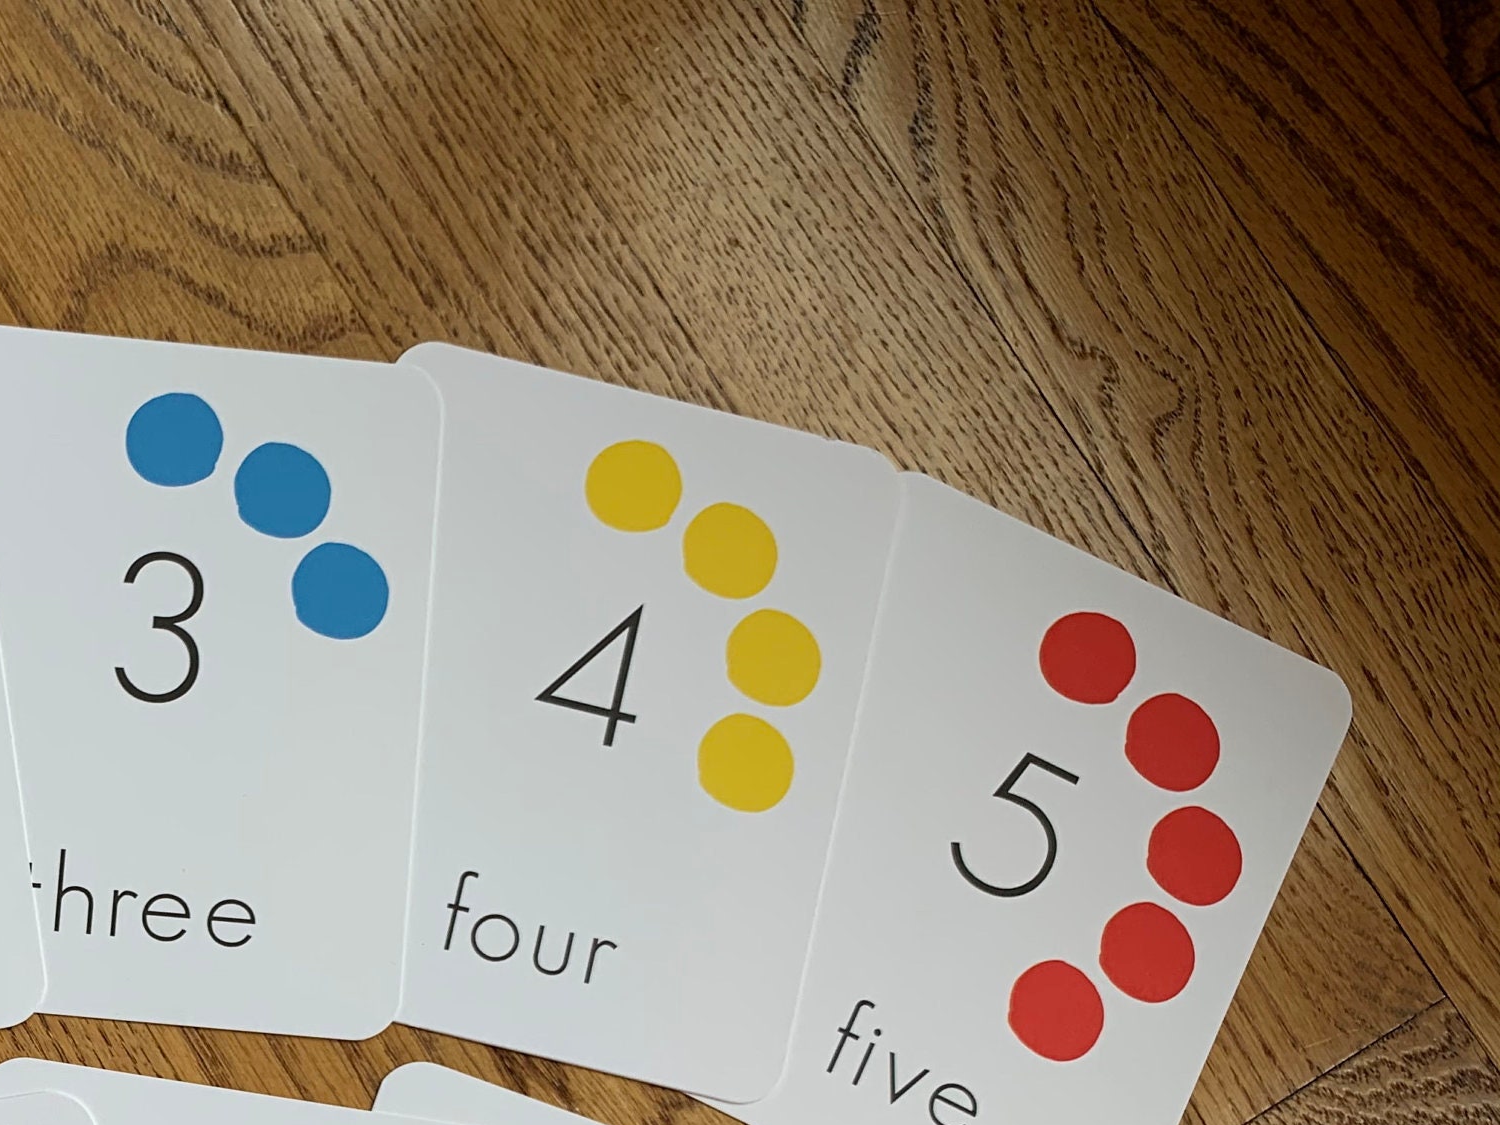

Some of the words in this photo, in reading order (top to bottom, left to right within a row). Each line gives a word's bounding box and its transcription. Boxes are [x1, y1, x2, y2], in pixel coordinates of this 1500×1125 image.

[113, 550, 205, 705] 3
[533, 603, 645, 748] 4
[949, 751, 1081, 899] 5
[443, 869, 619, 985] four
